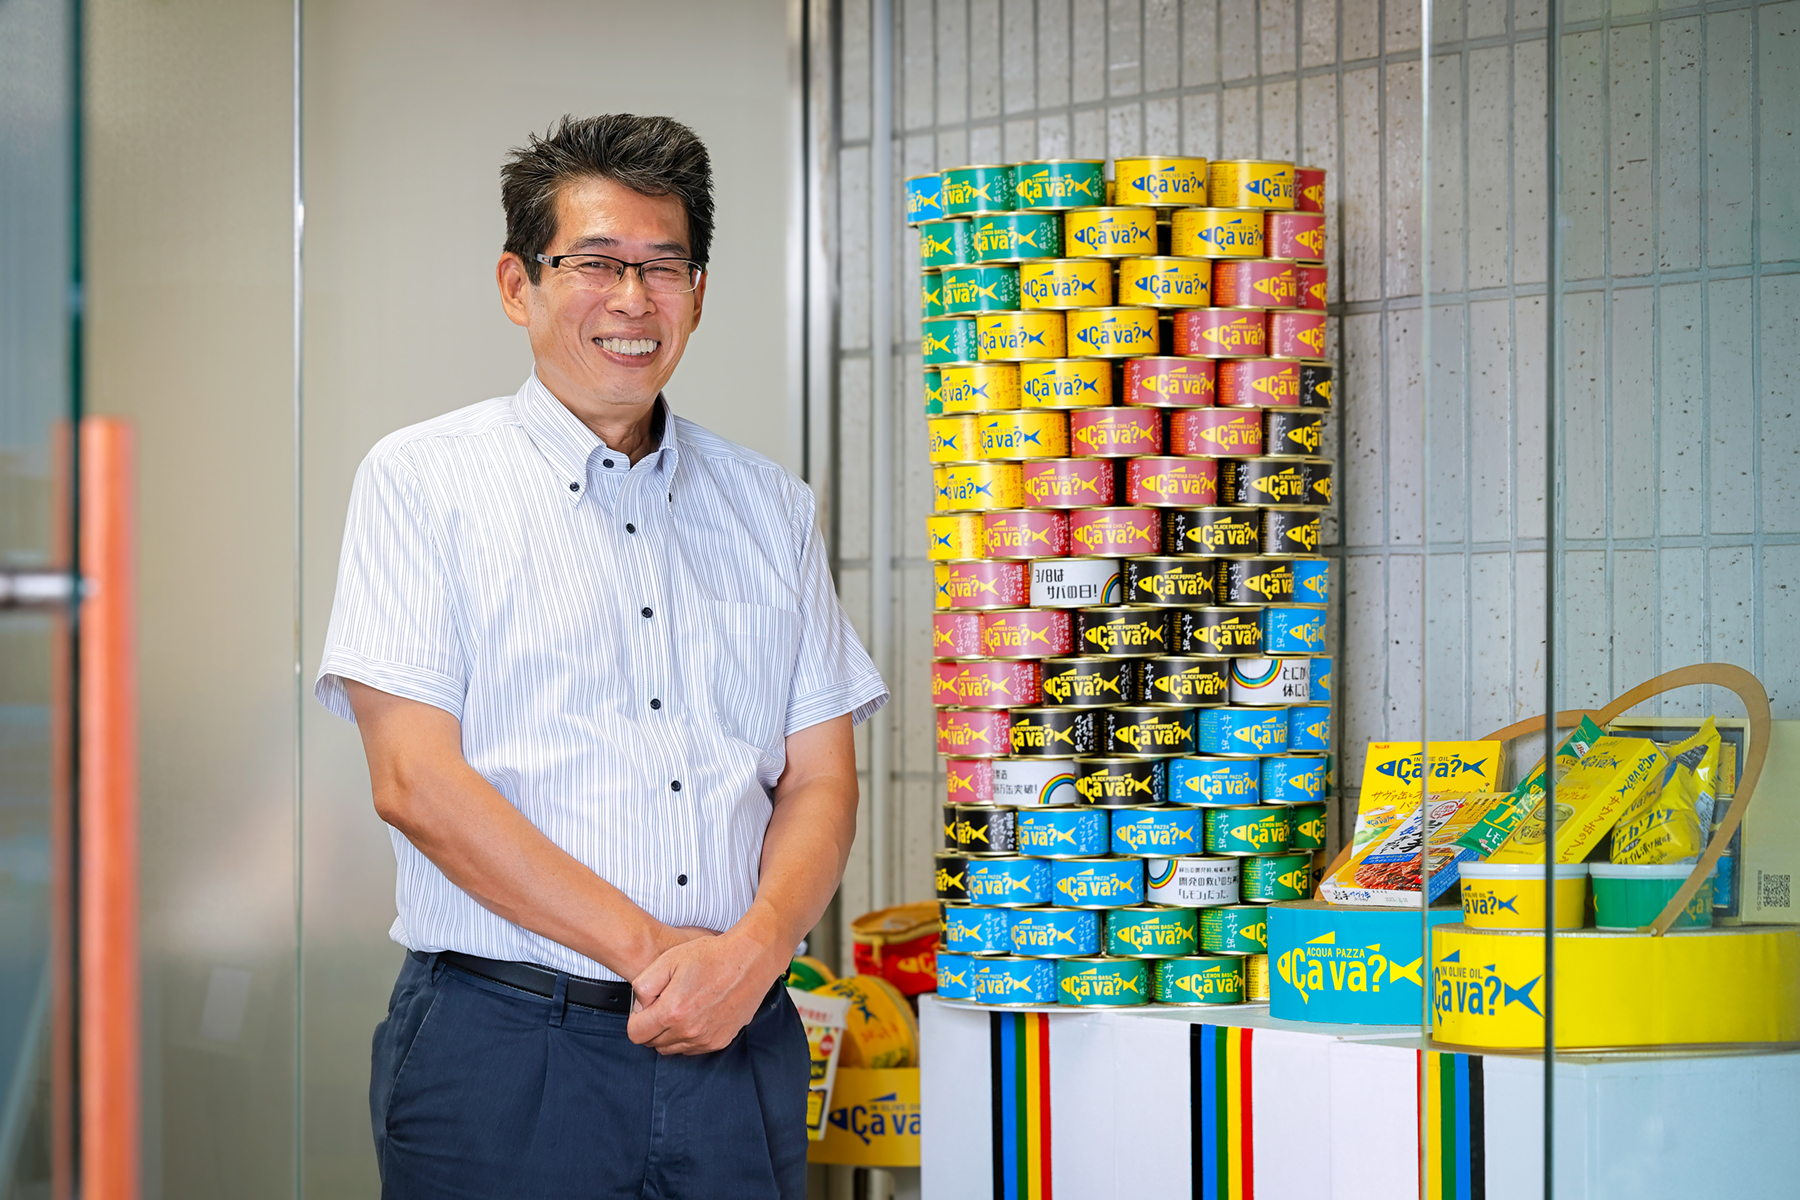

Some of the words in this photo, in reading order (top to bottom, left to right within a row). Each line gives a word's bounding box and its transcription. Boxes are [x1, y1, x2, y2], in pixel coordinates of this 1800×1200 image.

[1024, 179, 1042, 205] Ça
[1045, 180, 1072, 196] va?
[1147, 175, 1168, 199] Ça
[1174, 177, 1197, 193] va?
[1262, 178, 1280, 202] Ça
[991, 231, 1017, 250] va?
[1086, 227, 1107, 251] Ça
[1111, 227, 1138, 244] va?
[1214, 227, 1234, 251] Ça
[955, 285, 979, 303] va?
[1031, 280, 1047, 303] Ça
[1052, 279, 1080, 296] va?
[1150, 275, 1171, 299] Ça
[1176, 278, 1200, 294] va?
[1270, 277, 1287, 303] Ça
[1000, 331, 1027, 349] va?
[1090, 326, 1110, 351] Ça
[1114, 326, 1141, 344] va?
[1190, 315, 1200, 352] サヴァ缶
[1219, 325, 1240, 351] Ça
[1243, 326, 1262, 345] va?
[949, 384, 970, 401] va?
[1032, 378, 1050, 403] Ça
[1054, 378, 1082, 396] va?
[1131, 364, 1140, 400] サヴァ缶
[1157, 374, 1179, 400] Ça
[1184, 375, 1207, 394] va?
[1268, 376, 1287, 402] Ça
[996, 431, 1023, 448] va?
[1087, 425, 1107, 451] Ça
[1110, 426, 1139, 444] va?
[1187, 415, 1198, 452] サヴァ缶
[1217, 425, 1239, 451] Ça
[1242, 426, 1260, 445] va?
[1274, 415, 1286, 452] サヴァ缶
[953, 482, 974, 499] va?
[1032, 476, 1049, 503] Ça
[1052, 477, 1081, 495] va?
[1132, 464, 1140, 500] サヴァ缶
[1156, 474, 1179, 500] Ça
[1184, 474, 1207, 495] va?
[1238, 462, 1250, 501] サヴァ缶
[1268, 475, 1288, 502] Ça
[1006, 528, 1032, 547] va?
[1083, 525, 1103, 551] Ça
[1106, 526, 1135, 544] va?
[1175, 514, 1185, 551] サヴァ缶
[1202, 525, 1225, 551] Ça
[1227, 526, 1251, 545] va?
[1274, 514, 1285, 551] サヴァ缶
[961, 580, 979, 597] va?
[1035, 568, 1064, 583] 3/8は
[1129, 564, 1137, 600] サヴァ缶
[1152, 574, 1175, 601] Ça
[1180, 576, 1204, 595] va?
[1230, 564, 1242, 600] サヴァ缶
[1260, 574, 1280, 600] Ça
[1047, 584, 1097, 599] サバの日!
[1005, 628, 1030, 646] va?
[1097, 626, 1117, 652] Ça
[1120, 627, 1150, 645] va?
[1182, 614, 1192, 650] サヴァ缶
[1210, 625, 1232, 652] Ça
[1234, 627, 1257, 645] va?
[1275, 613, 1288, 648] サヴァ缶
[971, 679, 990, 696] va?
[1052, 676, 1071, 703] Ça
[1076, 675, 1103, 695] va?
[1144, 664, 1153, 700] サヴァ缶
[1170, 675, 1192, 701] Ça
[1195, 676, 1219, 695] va?
[1026, 727, 1054, 746] va?
[1129, 725, 1151, 752] Ça
[1154, 726, 1180, 744] va?
[1220, 714, 1232, 750] サヴァ缶
[1251, 725, 1271, 750] Ça
[1274, 762, 1287, 798] サヴァ缶
[1397, 758, 1423, 785] Ça
[1085, 777, 1105, 804] Ça
[1108, 778, 1134, 796] va?
[1200, 775, 1222, 801] Ça
[1226, 776, 1250, 794] va?
[1305, 773, 1320, 798] Ça
[1031, 828, 1057, 846] va?
[1126, 825, 1147, 851] Ça
[1150, 827, 1179, 845] va?
[1217, 813, 1228, 848] サヴァ缶
[1248, 824, 1269, 850] Ça
[985, 877, 1010, 895] va?
[1068, 877, 1088, 903] Ça
[1091, 877, 1119, 896] va?
[1263, 861, 1276, 896] サヴァ缶
[1293, 870, 1308, 896] Ça
[1472, 896, 1496, 914] va?
[1029, 926, 1057, 946] va?
[1131, 926, 1152, 952] Ça
[1155, 928, 1182, 945] va?
[1225, 913, 1237, 949] サヴァ缶
[1307, 947, 1332, 957] ACQUA
[1336, 948, 1365, 958] PAZZA
[988, 974, 1013, 995] va?
[1164, 963, 1173, 999] サヴァ缶
[1292, 948, 1324, 1005] Ça
[1329, 954, 1387, 992] va?
[1440, 966, 1447, 975] IN
[1449, 967, 1466, 978] OLIVE
[1470, 968, 1483, 979] OIL
[1070, 976, 1090, 1002] Ça
[1093, 975, 1122, 996] va?
[1192, 974, 1214, 1000] Ça
[1216, 974, 1239, 994] va?
[1434, 967, 1452, 1027] Ça
[1457, 976, 1502, 1016] va?
[852, 1106, 885, 1146] Ça
